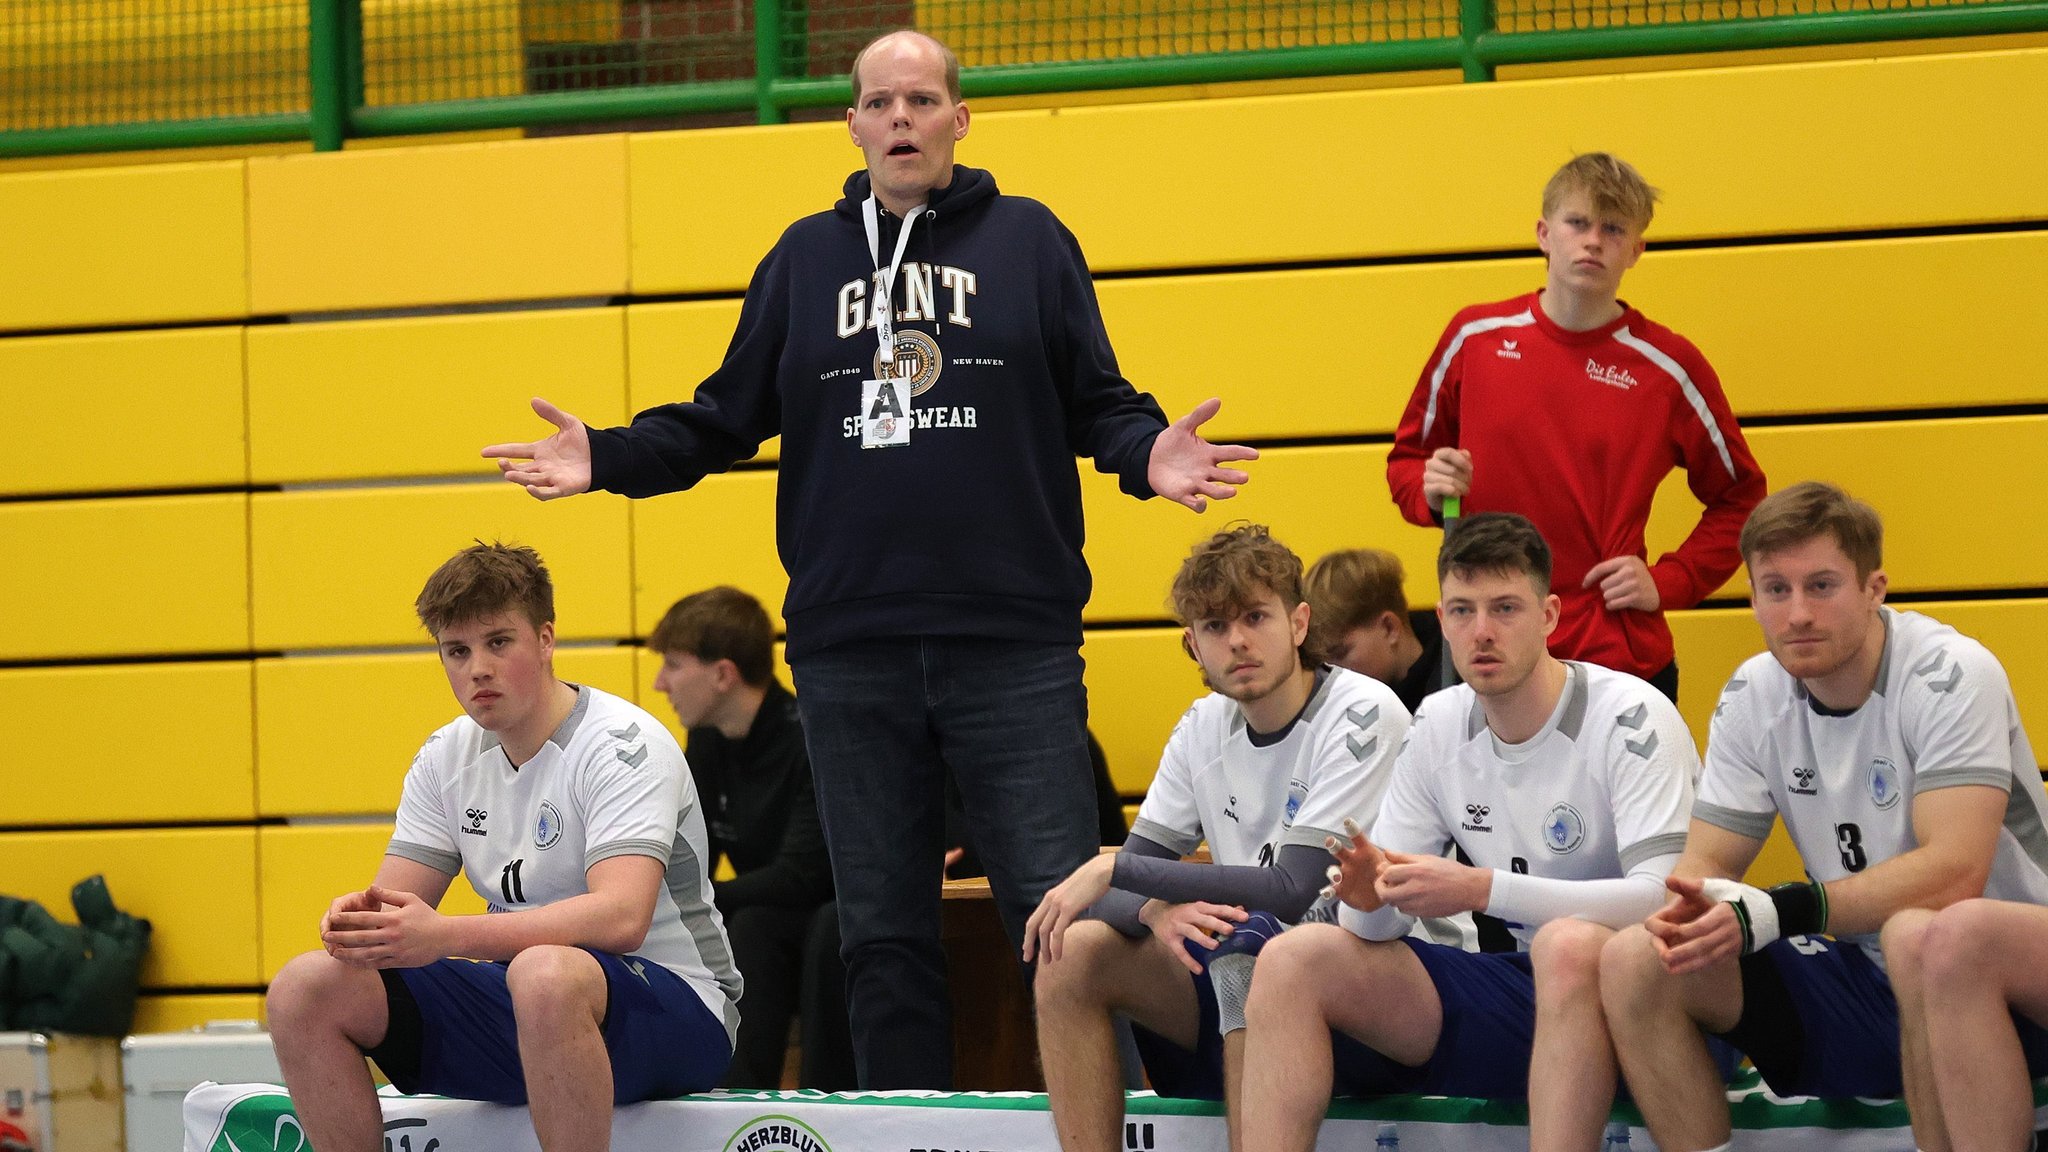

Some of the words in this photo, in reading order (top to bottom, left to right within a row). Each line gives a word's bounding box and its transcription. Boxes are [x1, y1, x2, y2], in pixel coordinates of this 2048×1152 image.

[952, 357, 973, 367] NEW
[975, 357, 1005, 367] HAVEN
[1496, 350, 1521, 360] erima
[820, 369, 840, 381] GANT
[842, 367, 861, 376] 1949
[1586, 358, 1605, 375] Die
[1605, 364, 1638, 387] Eulen
[868, 382, 904, 420] A
[843, 406, 977, 438] SPSWEAR
[1462, 822, 1492, 833] hummel
[501, 858, 526, 904] 11
[737, 1125, 824, 1152] HERZBLUT
